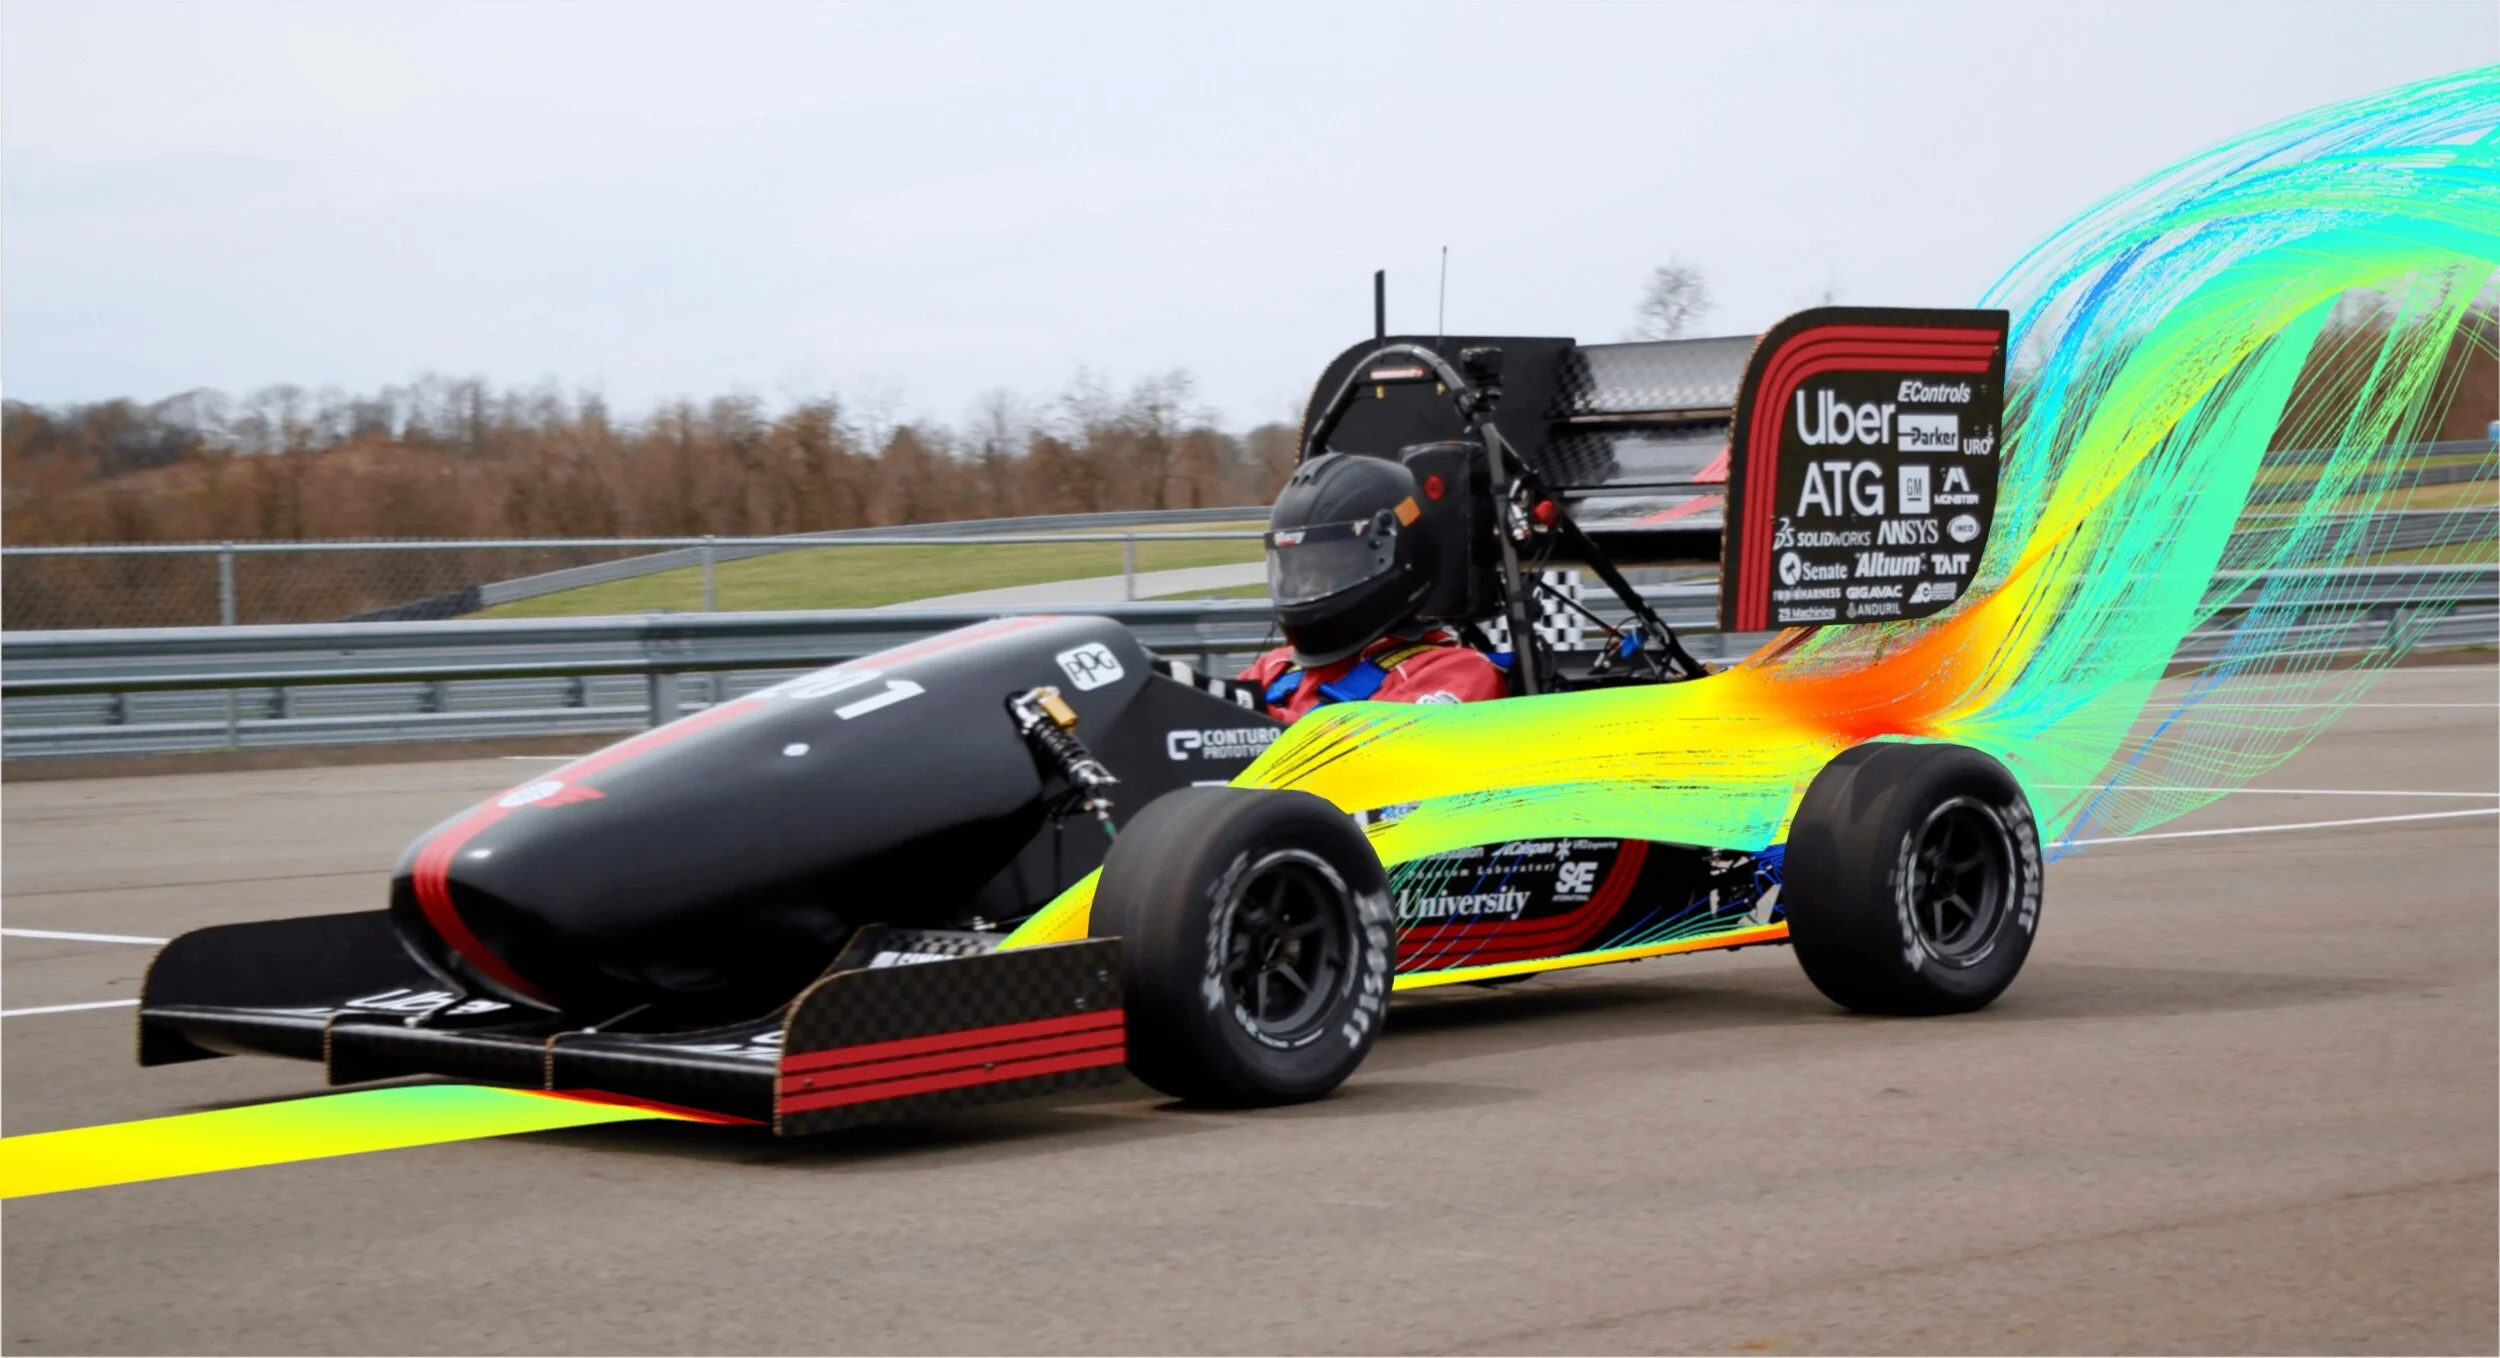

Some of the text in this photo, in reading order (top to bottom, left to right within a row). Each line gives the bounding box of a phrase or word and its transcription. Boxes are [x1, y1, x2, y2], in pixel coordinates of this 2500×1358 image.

[1898, 380, 1972, 403] EControls
[1796, 389, 1896, 446] Uber
[1911, 426, 1957, 446] Parker
[1796, 460, 1885, 518] ATG
[1906, 477, 1923, 496] GM
[1797, 531, 1872, 547] SOLIDWORKS
[1876, 519, 1939, 546] ANSYS
[1802, 562, 1848, 581] Senate
[1854, 552, 1922, 578] Altium
[1931, 554, 1969, 575] TAIT
[1846, 585, 1903, 599] GIGAVAC
[1857, 603, 1901, 616] ANDURIL
[1065, 651, 1117, 683] PPG
[1202, 727, 1281, 746] CONTURO
[1203, 744, 1268, 759] PROTOTYP
[1555, 861, 1599, 893] SAE
[1399, 884, 1532, 920] University
